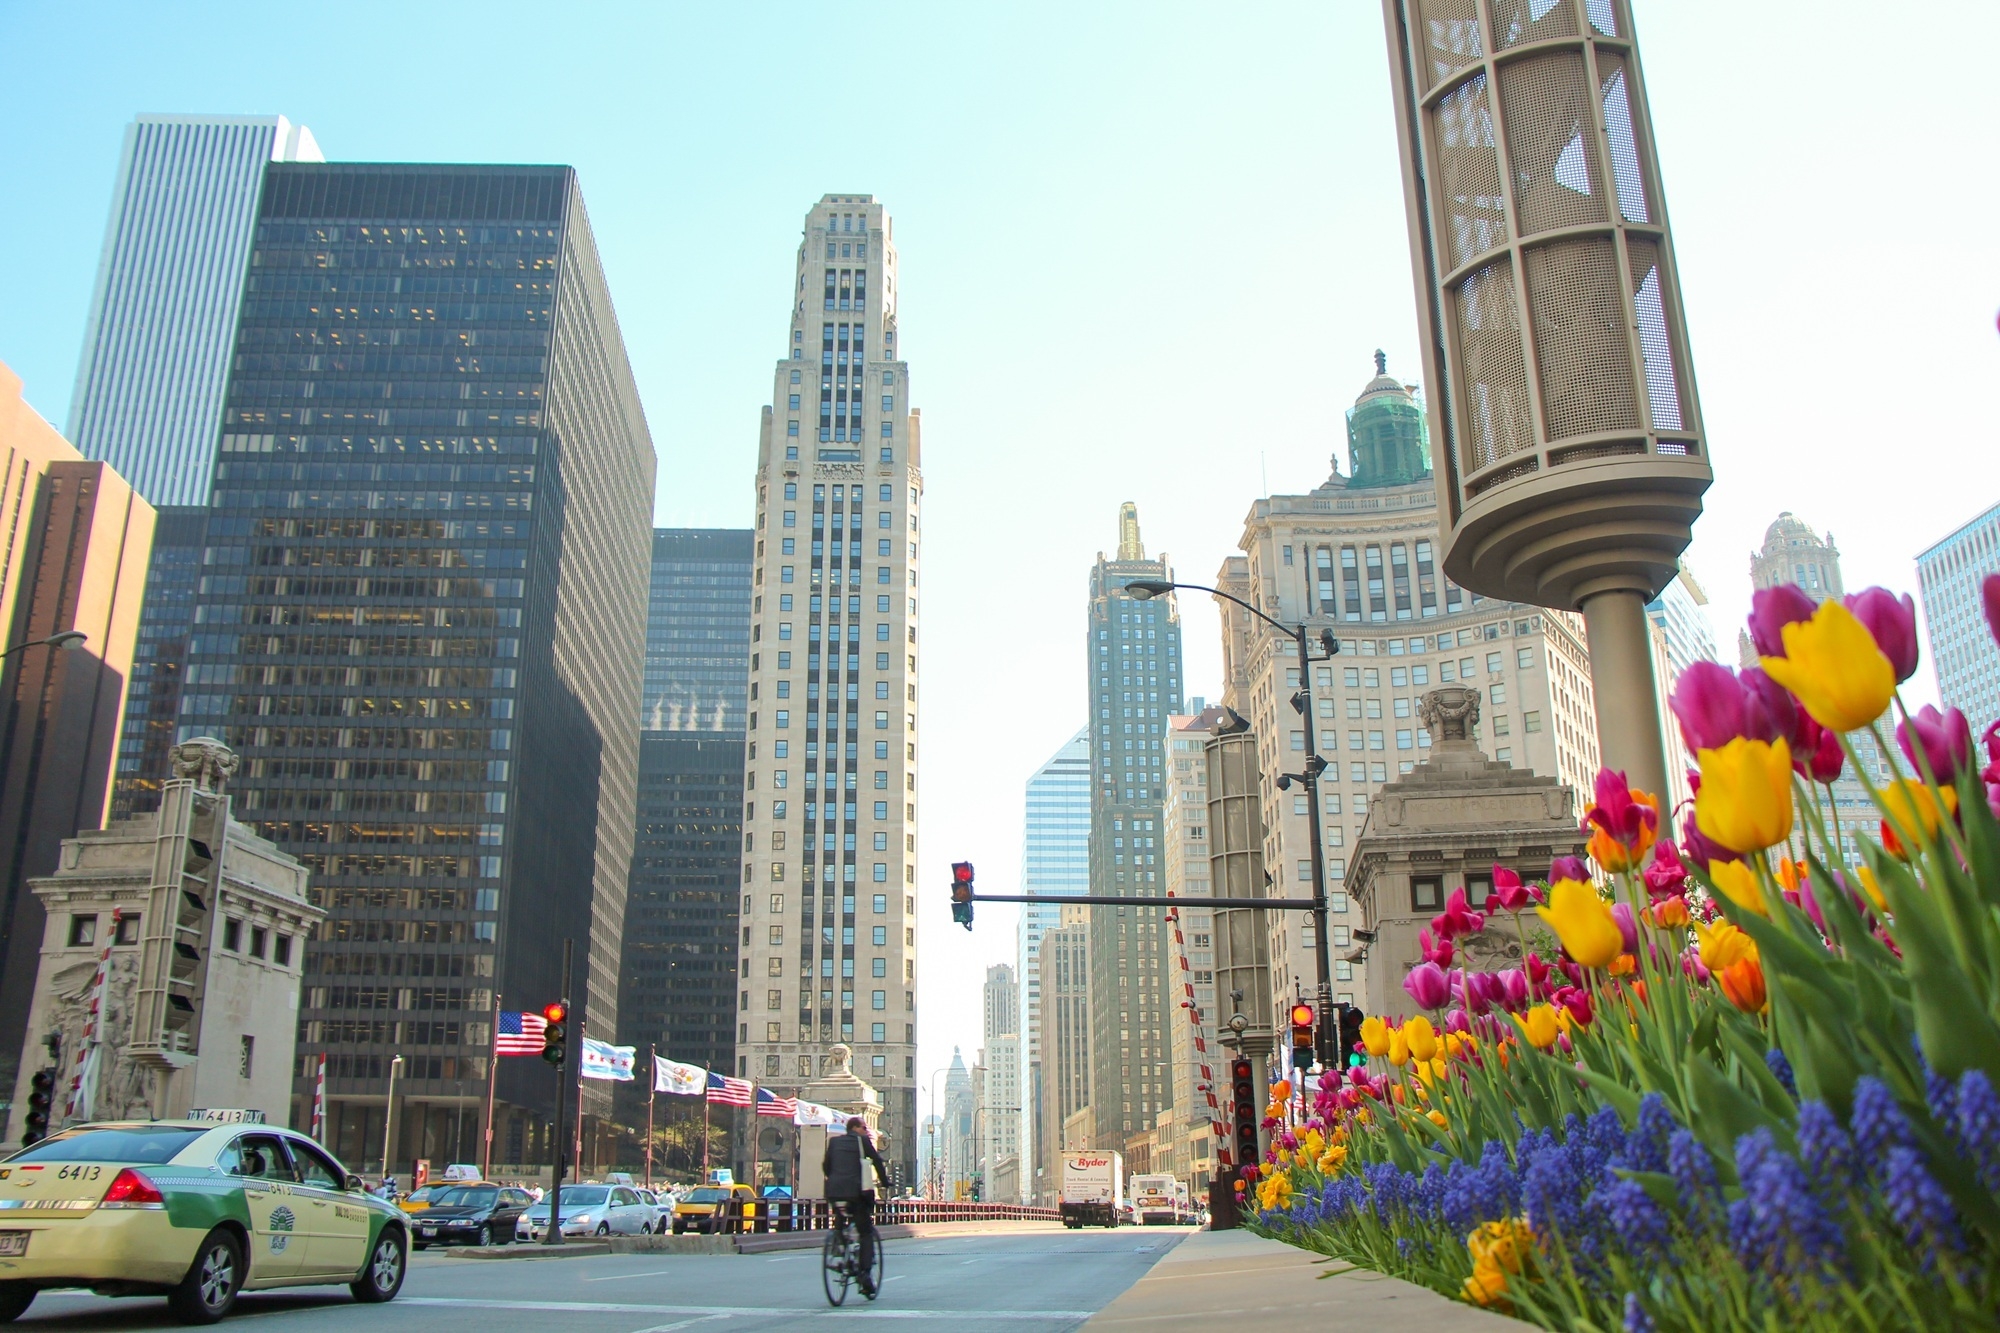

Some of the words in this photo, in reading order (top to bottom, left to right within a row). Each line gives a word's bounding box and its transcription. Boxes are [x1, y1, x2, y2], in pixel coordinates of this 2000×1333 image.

[1410, 801, 1458, 813] MICHIGAN
[1460, 799, 1497, 811] AVENUE
[1499, 798, 1537, 810] BRIDGE
[206, 1111, 241, 1122] 6413
[1078, 1158, 1108, 1167] Ryder
[58, 1165, 101, 1180] 6413
[270, 1184, 291, 1196] 6413
